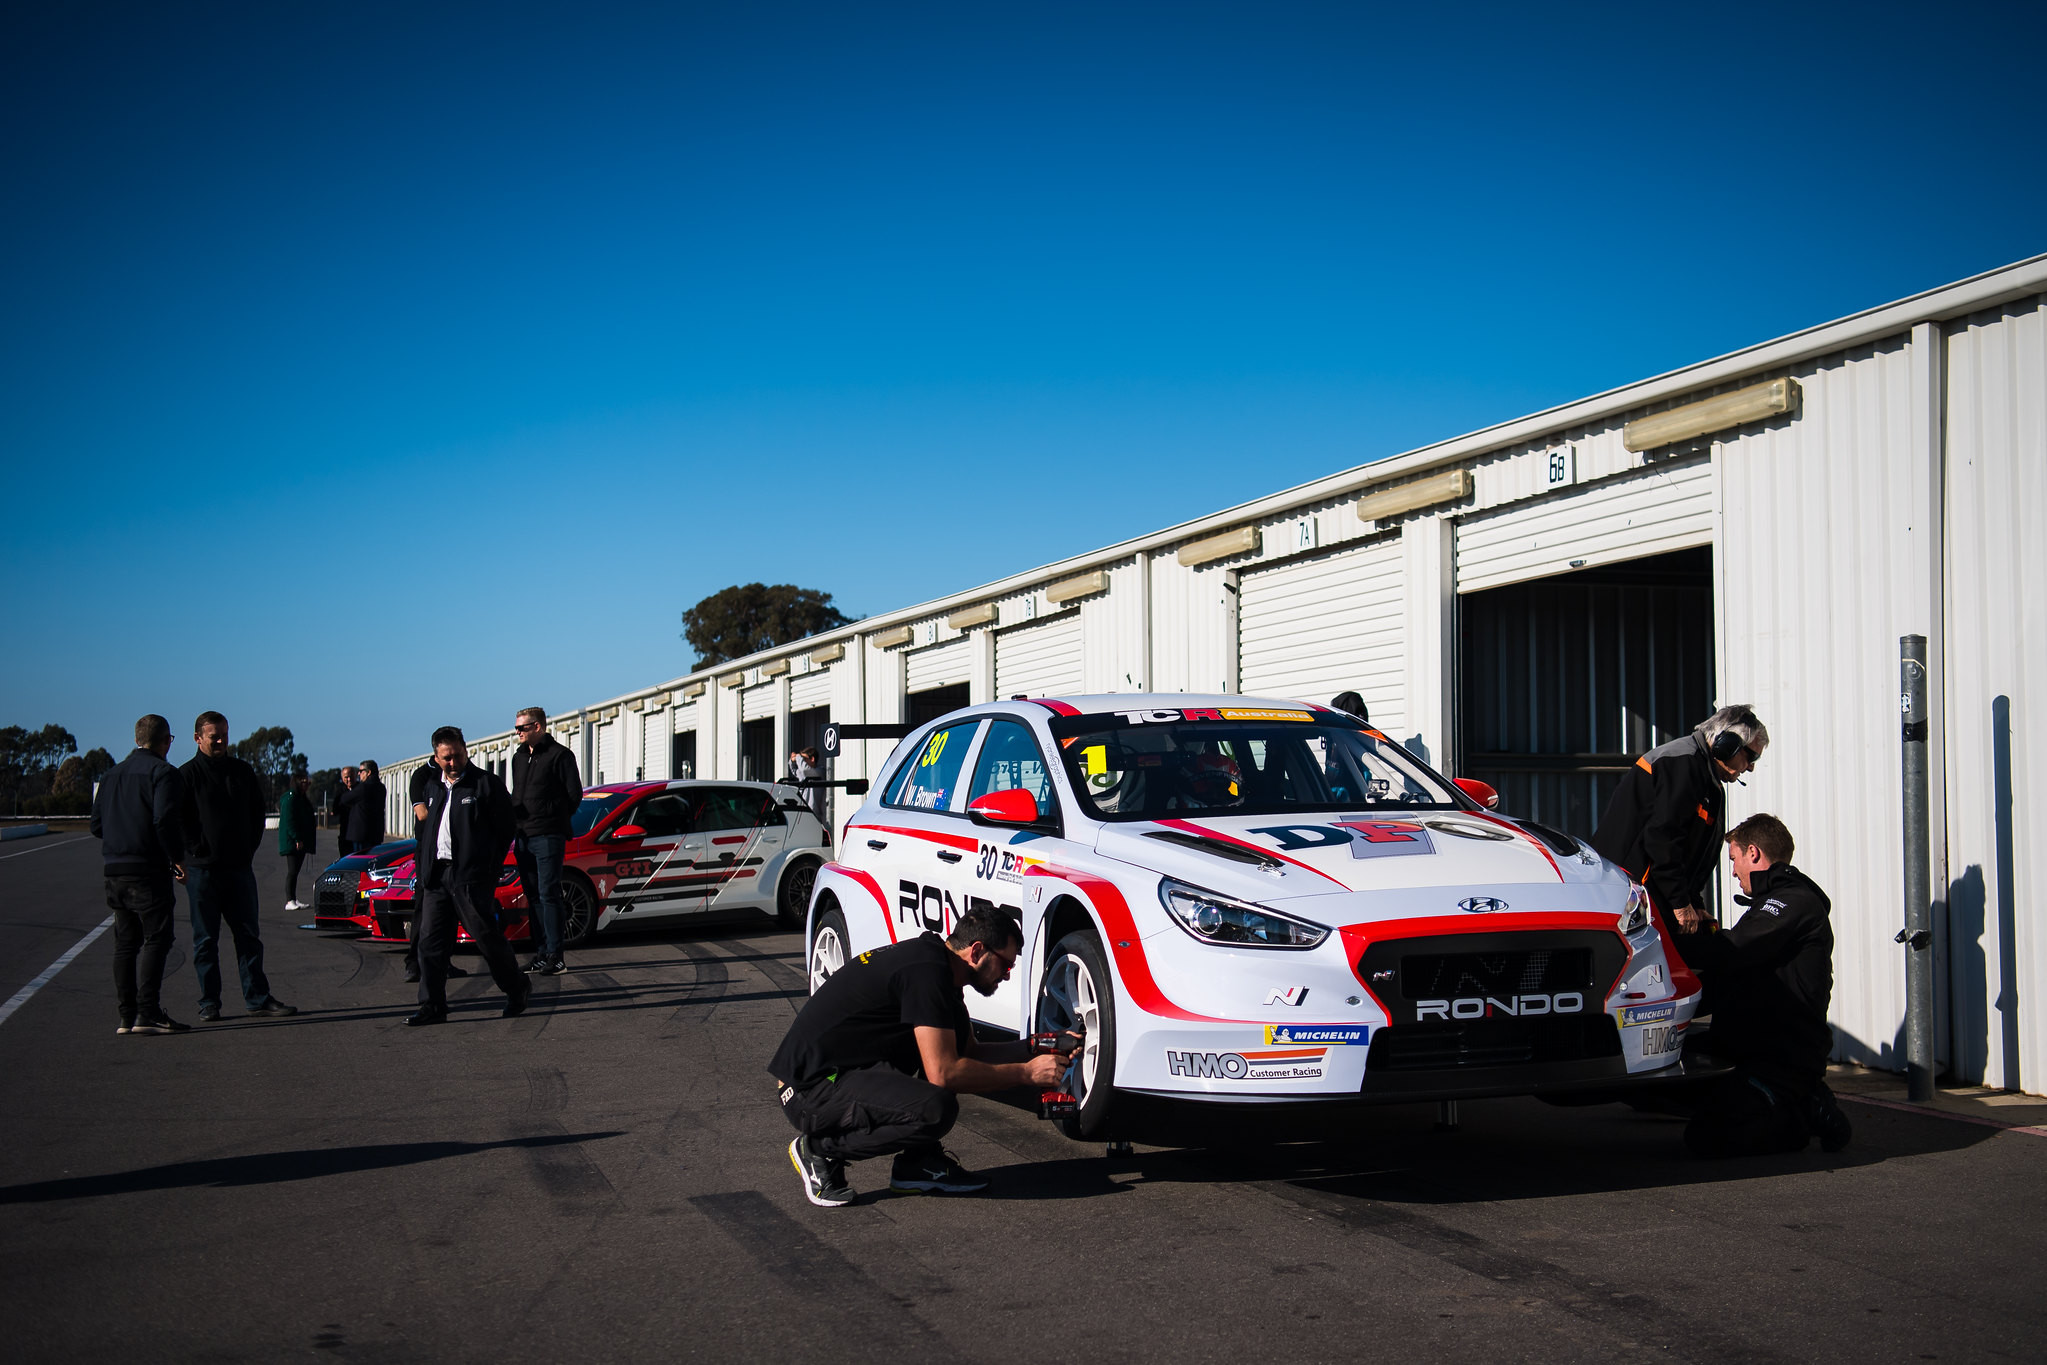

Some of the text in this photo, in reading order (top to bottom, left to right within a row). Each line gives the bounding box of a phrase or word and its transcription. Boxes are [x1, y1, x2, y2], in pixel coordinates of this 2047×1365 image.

[1550, 452, 1565, 483] 6B
[1299, 521, 1311, 547] 7A
[1113, 708, 1309, 725] TCR Australia
[921, 731, 949, 768] 30
[914, 785, 938, 809] Brown
[615, 861, 652, 878] GTI
[976, 843, 998, 881] 30
[1001, 850, 1024, 874] TCR
[898, 878, 1024, 945] RON
[1416, 991, 1584, 1022] RONDO
[1636, 1007, 1673, 1021] MICHELIN
[1293, 1031, 1361, 1040] MICHELIN
[1642, 1025, 1679, 1056] HMO
[1167, 1050, 1322, 1080] HMO Customer Racing
